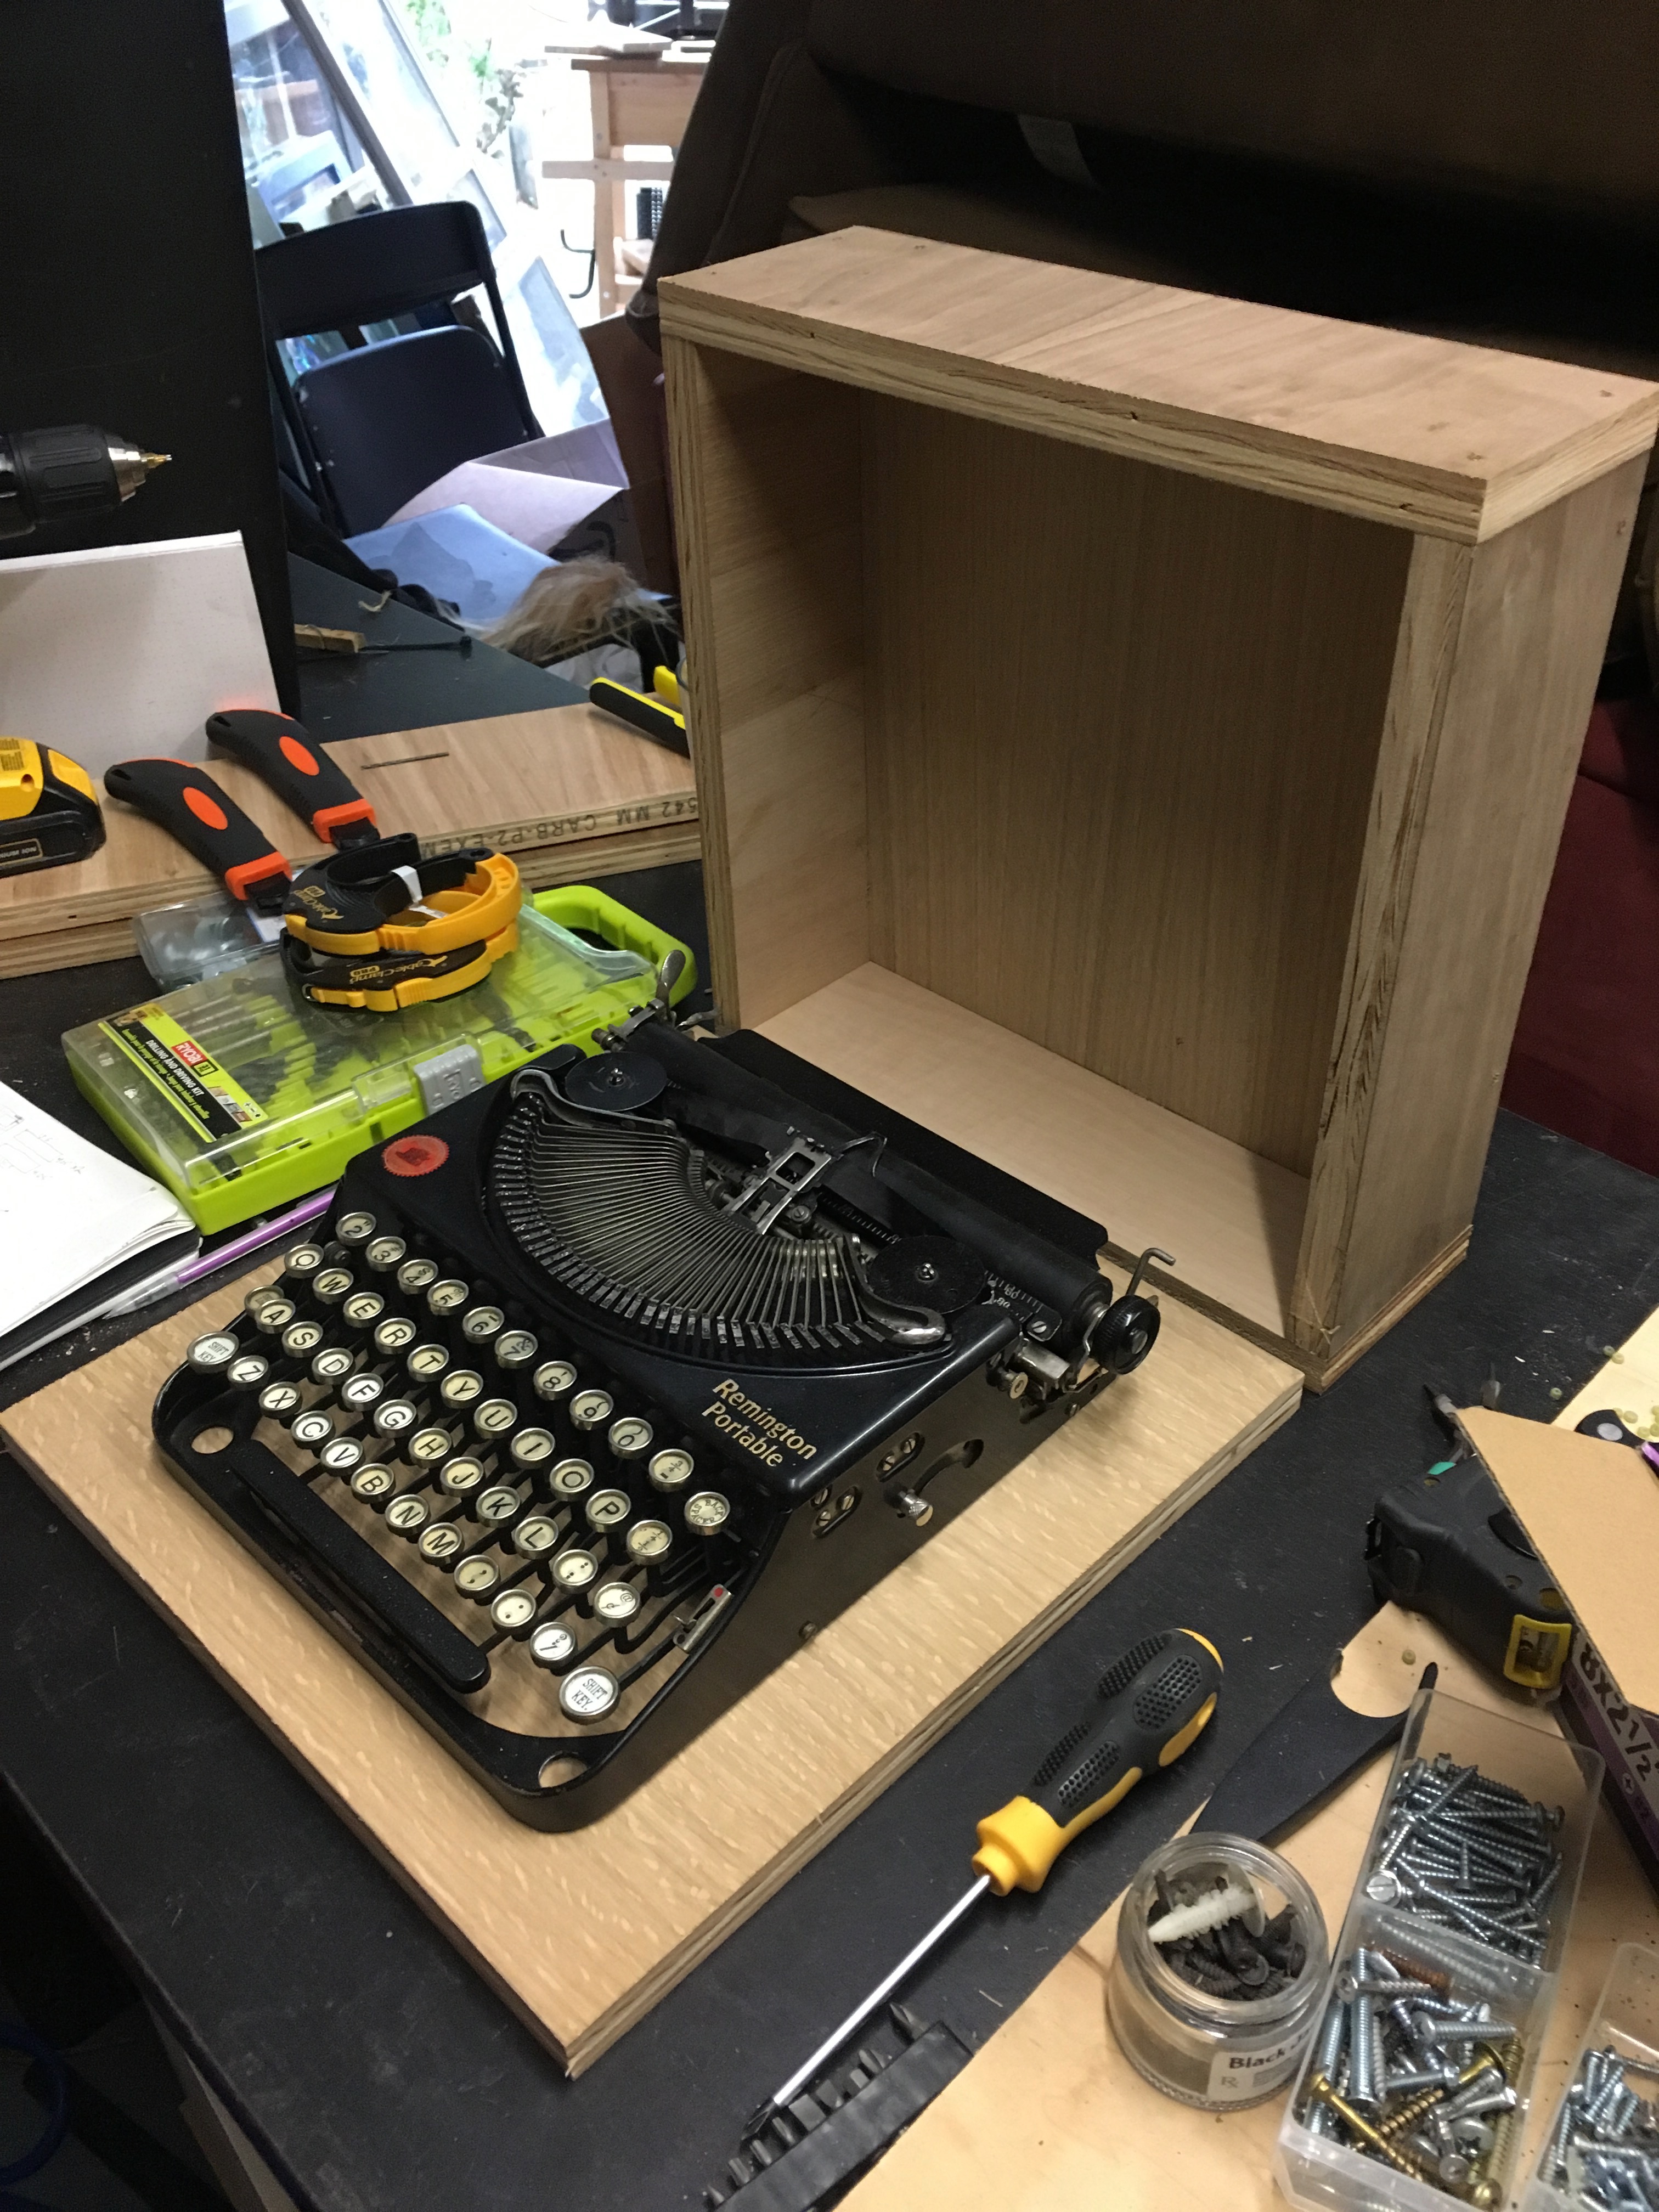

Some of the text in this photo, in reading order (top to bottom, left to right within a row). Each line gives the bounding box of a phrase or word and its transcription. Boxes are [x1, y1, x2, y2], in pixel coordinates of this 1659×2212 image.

[616, 805, 651, 826] MM
[349, 955, 448, 985] CableClamp
[351, 966, 379, 977] PRO
[176, 1042, 202, 1064] RYOBI
[145, 1039, 170, 1060] DRILLING
[163, 1057, 179, 1070] AND
[173, 1067, 194, 1088] DRIVING
[191, 1085, 205, 1097] KIT
[345, 1225, 363, 1235] 2
[292, 1253, 316, 1267] Q
[374, 1250, 391, 1262] 3
[321, 1276, 348, 1293] W
[405, 1276, 421, 1284] 4
[435, 1294, 453, 1305] 5
[263, 1309, 286, 1324] A
[353, 1301, 377, 1317] E
[383, 1327, 408, 1344] R
[471, 1321, 489, 1333] 6
[292, 1331, 314, 1346] S
[207, 1341, 230, 1356] SHIFT
[503, 1345, 521, 1356] 7
[321, 1358, 345, 1373] D
[419, 1355, 442, 1370] T
[237, 1364, 262, 1381] Z
[351, 1384, 377, 1397] F
[452, 1380, 476, 1396] Y
[542, 1375, 561, 1389] 8
[268, 1390, 295, 1408] X
[383, 1410, 407, 1427] G
[484, 1409, 510, 1427] U
[577, 1406, 597, 1419] 9
[713, 1378, 818, 1460] Remington
[302, 1421, 325, 1438] C
[701, 1401, 783, 1467] Portable
[332, 1447, 356, 1464] V
[417, 1437, 445, 1457] H
[359, 1475, 384, 1493] B
[451, 1471, 476, 1485] J
[561, 1470, 585, 1488] O
[394, 1504, 422, 1526] N
[486, 1496, 514, 1517] K
[594, 1500, 621, 1516] P
[426, 1531, 456, 1555] M
[523, 1526, 544, 1549] L
[582, 1677, 608, 1700] SHIFT
[1229, 2047, 1286, 2070] Black
